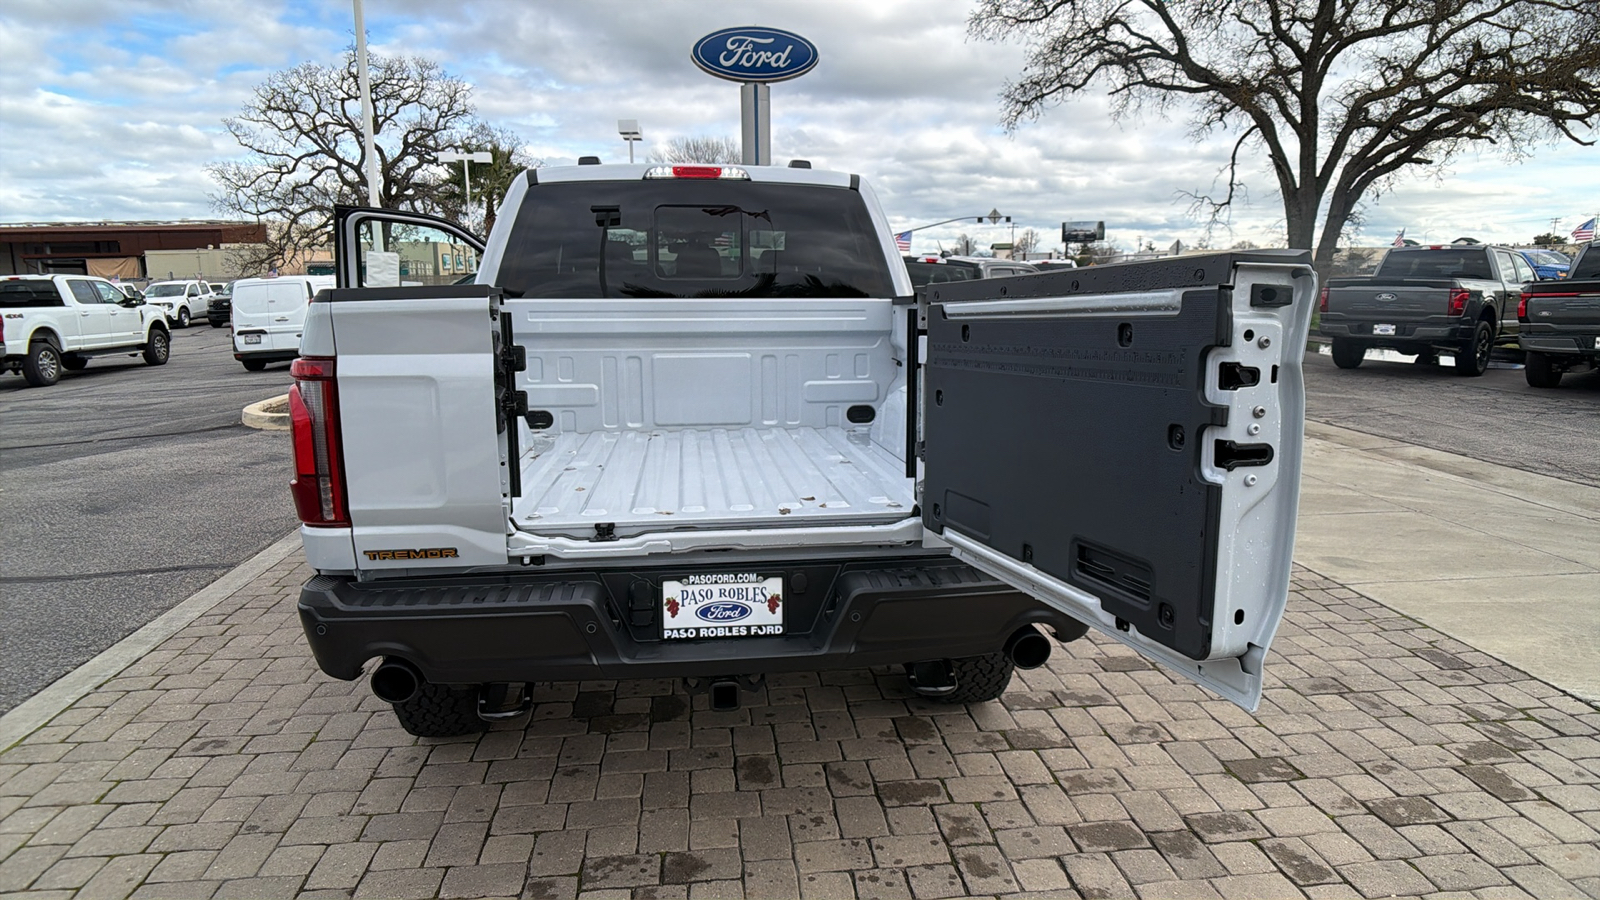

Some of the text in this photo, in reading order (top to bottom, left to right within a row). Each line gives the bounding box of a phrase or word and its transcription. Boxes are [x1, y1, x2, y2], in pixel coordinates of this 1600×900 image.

[719, 35, 793, 68] Ford
[363, 547, 459, 560] TREMOR
[689, 573, 757, 585] PASOFORD.COM
[680, 586, 768, 607] PASO ROBLES
[707, 605, 741, 619] Ford
[664, 625, 784, 639] PASO ROBLES FORD
